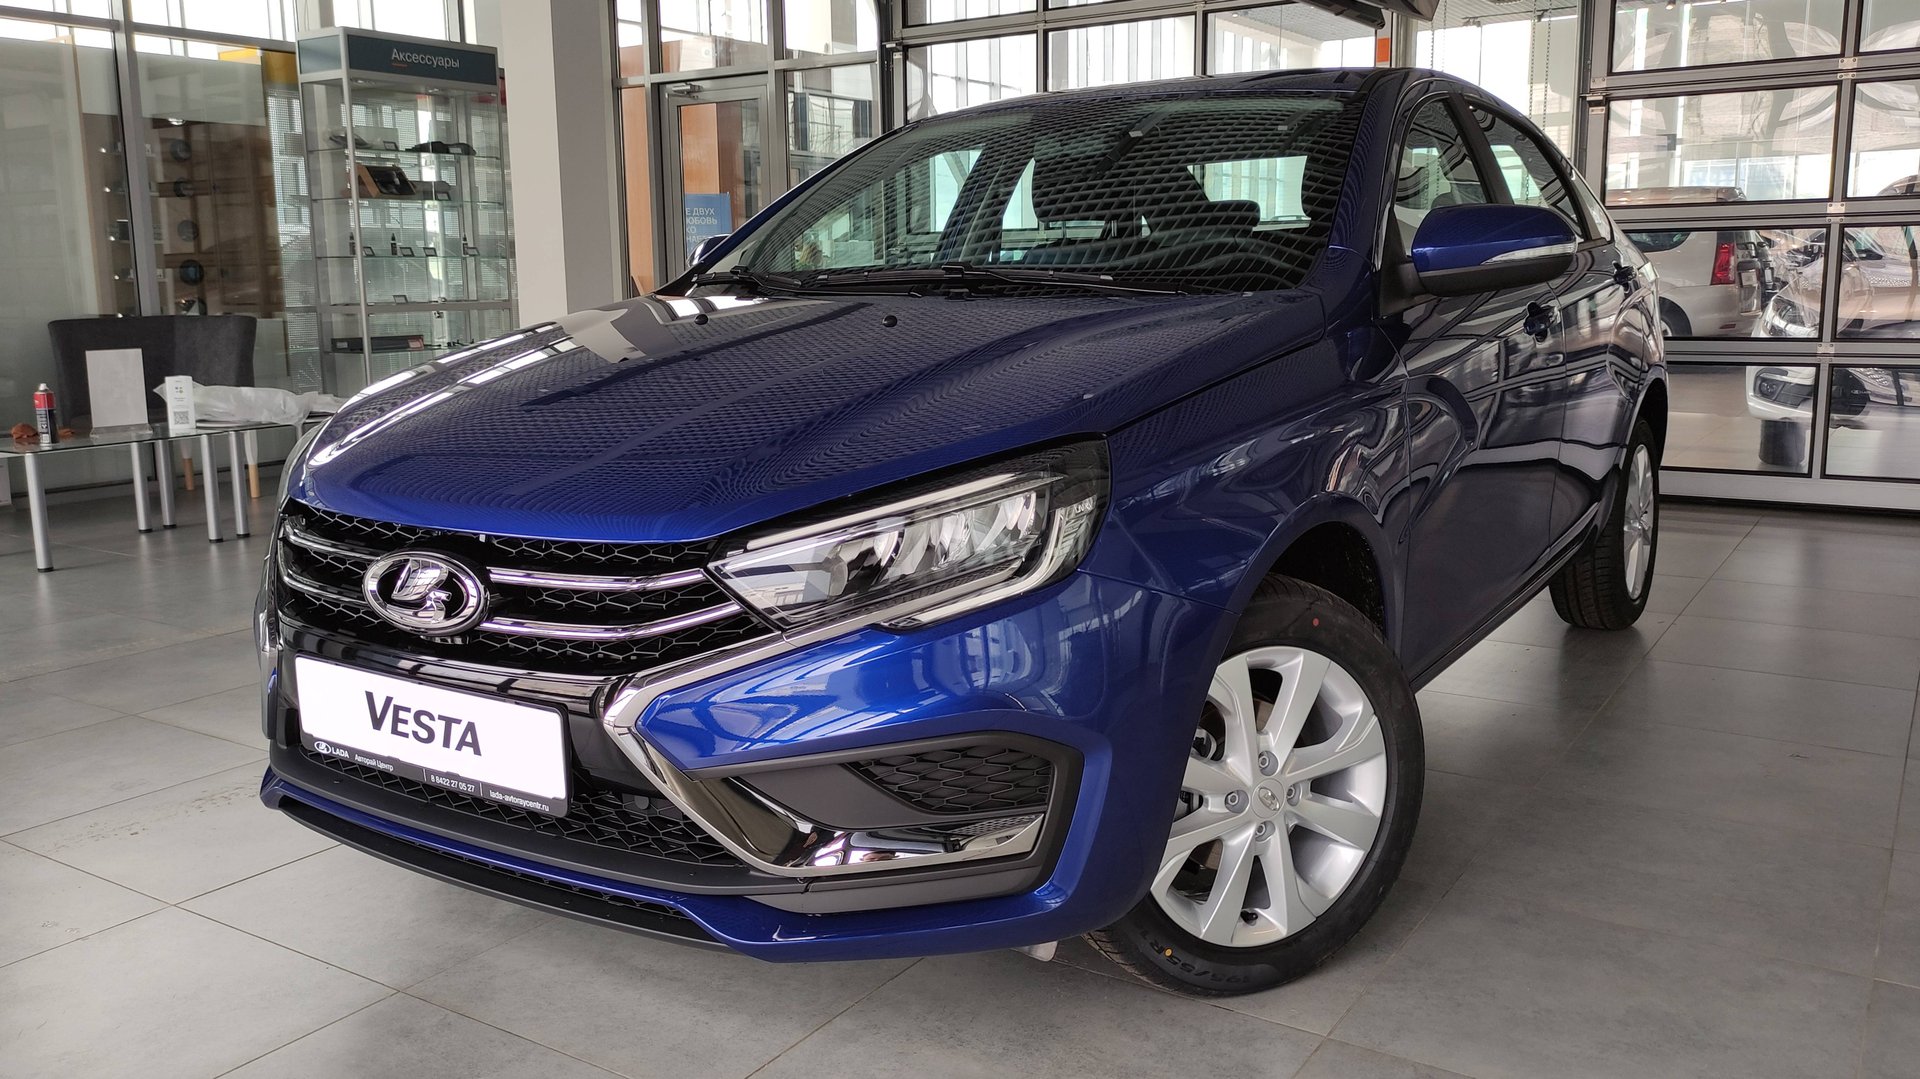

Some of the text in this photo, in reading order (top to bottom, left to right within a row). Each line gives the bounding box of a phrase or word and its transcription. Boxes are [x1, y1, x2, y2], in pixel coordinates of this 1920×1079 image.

[391, 48, 460, 69] Аксессуары
[693, 207, 715, 216] ДВУХ
[365, 690, 482, 757] VESTA
[331, 746, 550, 811] LADA Авторай Центр 8 8422 27 05 27 lada-avtoraycentr.ru
